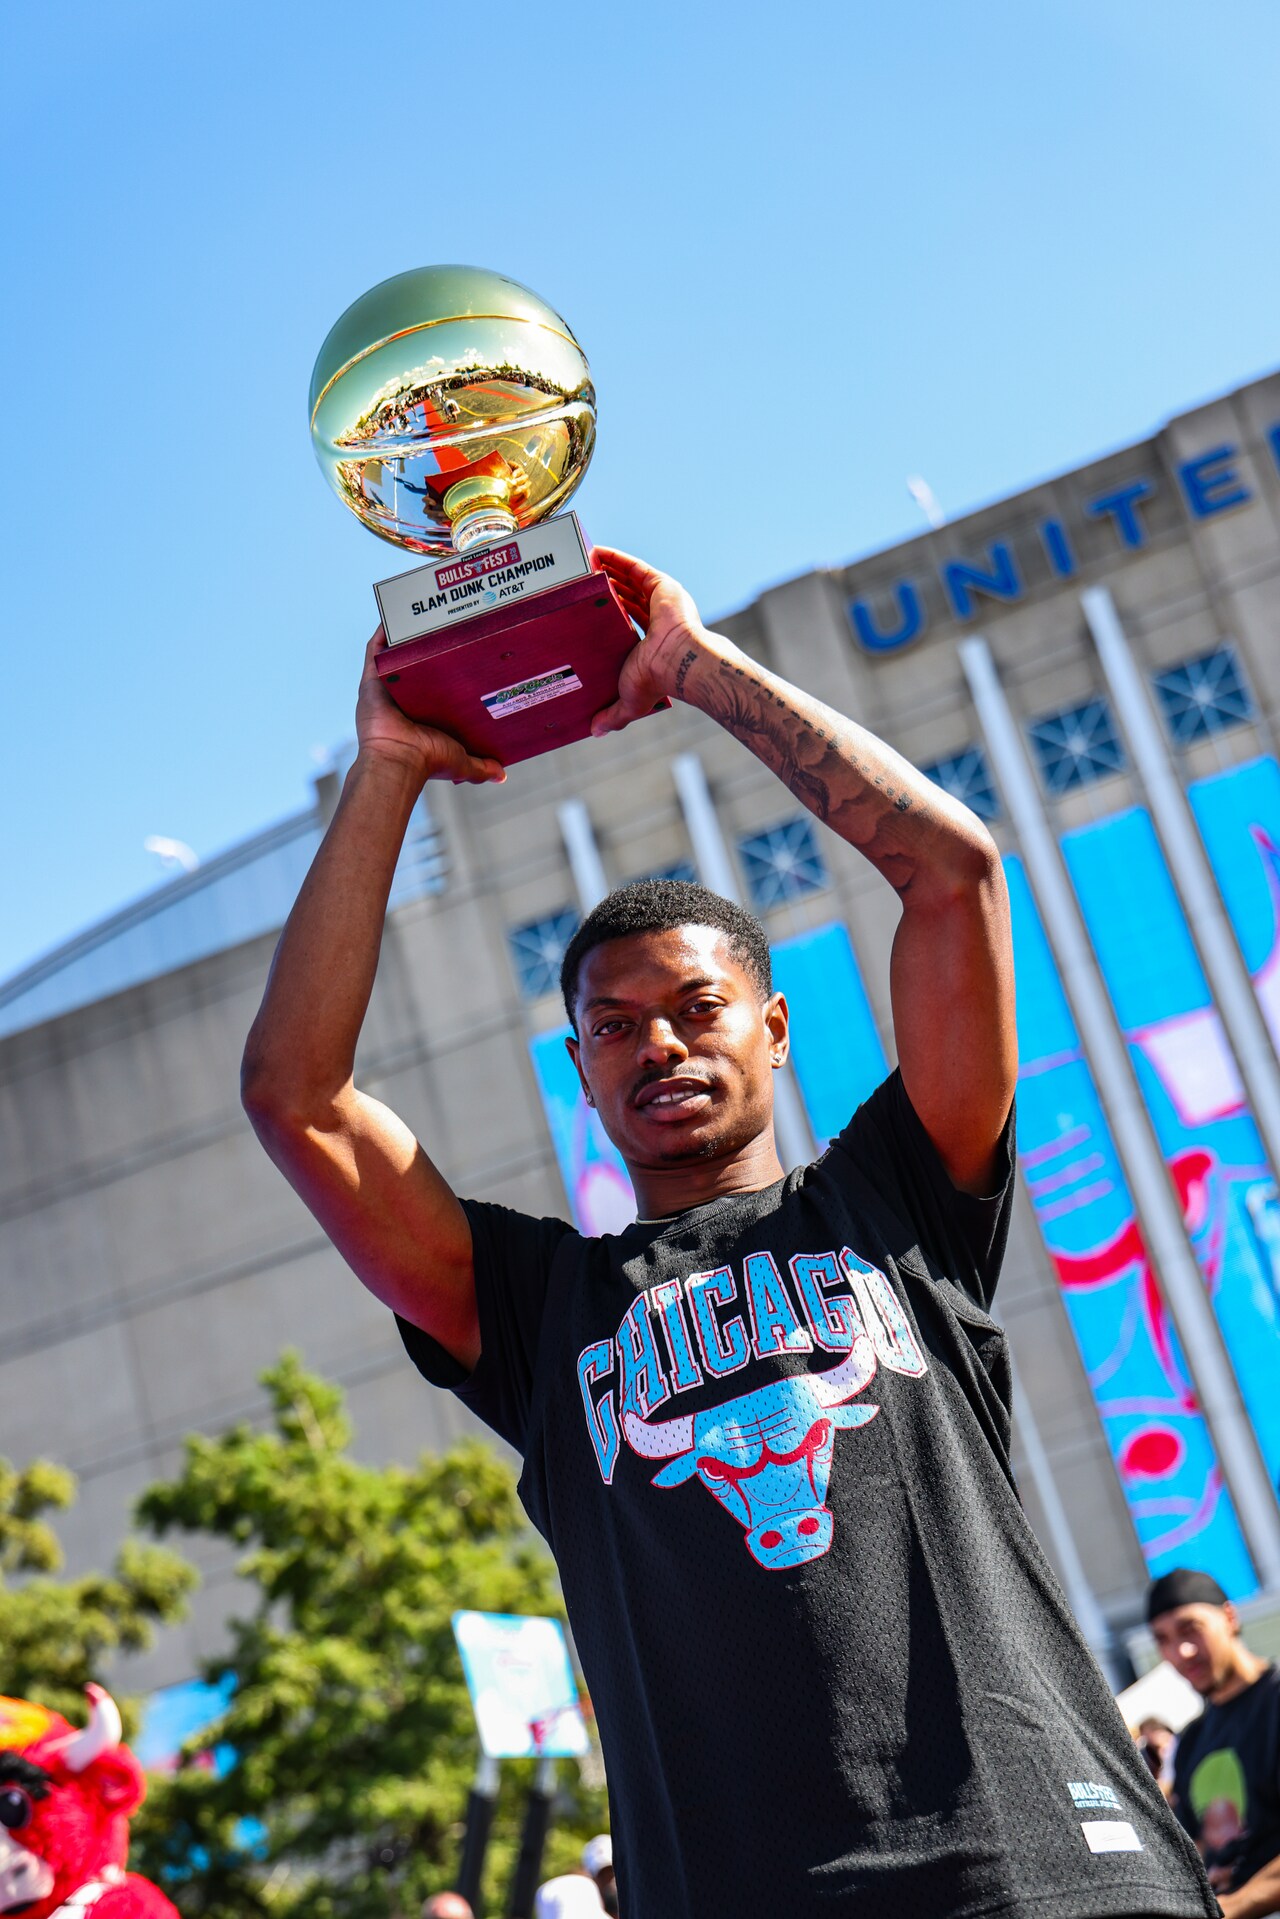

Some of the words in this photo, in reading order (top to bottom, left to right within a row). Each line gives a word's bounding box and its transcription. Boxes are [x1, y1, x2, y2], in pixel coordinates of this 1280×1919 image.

[473, 549, 489, 559] Locker
[850, 423, 1280, 652] UNITE
[412, 592, 448, 616] SLAM
[450, 578, 485, 602] DUNK
[488, 553, 555, 588] CHAMPION
[438, 564, 473, 586] BULLS
[482, 550, 507, 570] FEST
[447, 601, 473, 615] PRESENTED
[473, 599, 480, 607] BY
[499, 581, 525, 599] AT&T
[577, 1246, 929, 1485] CHICAGO
